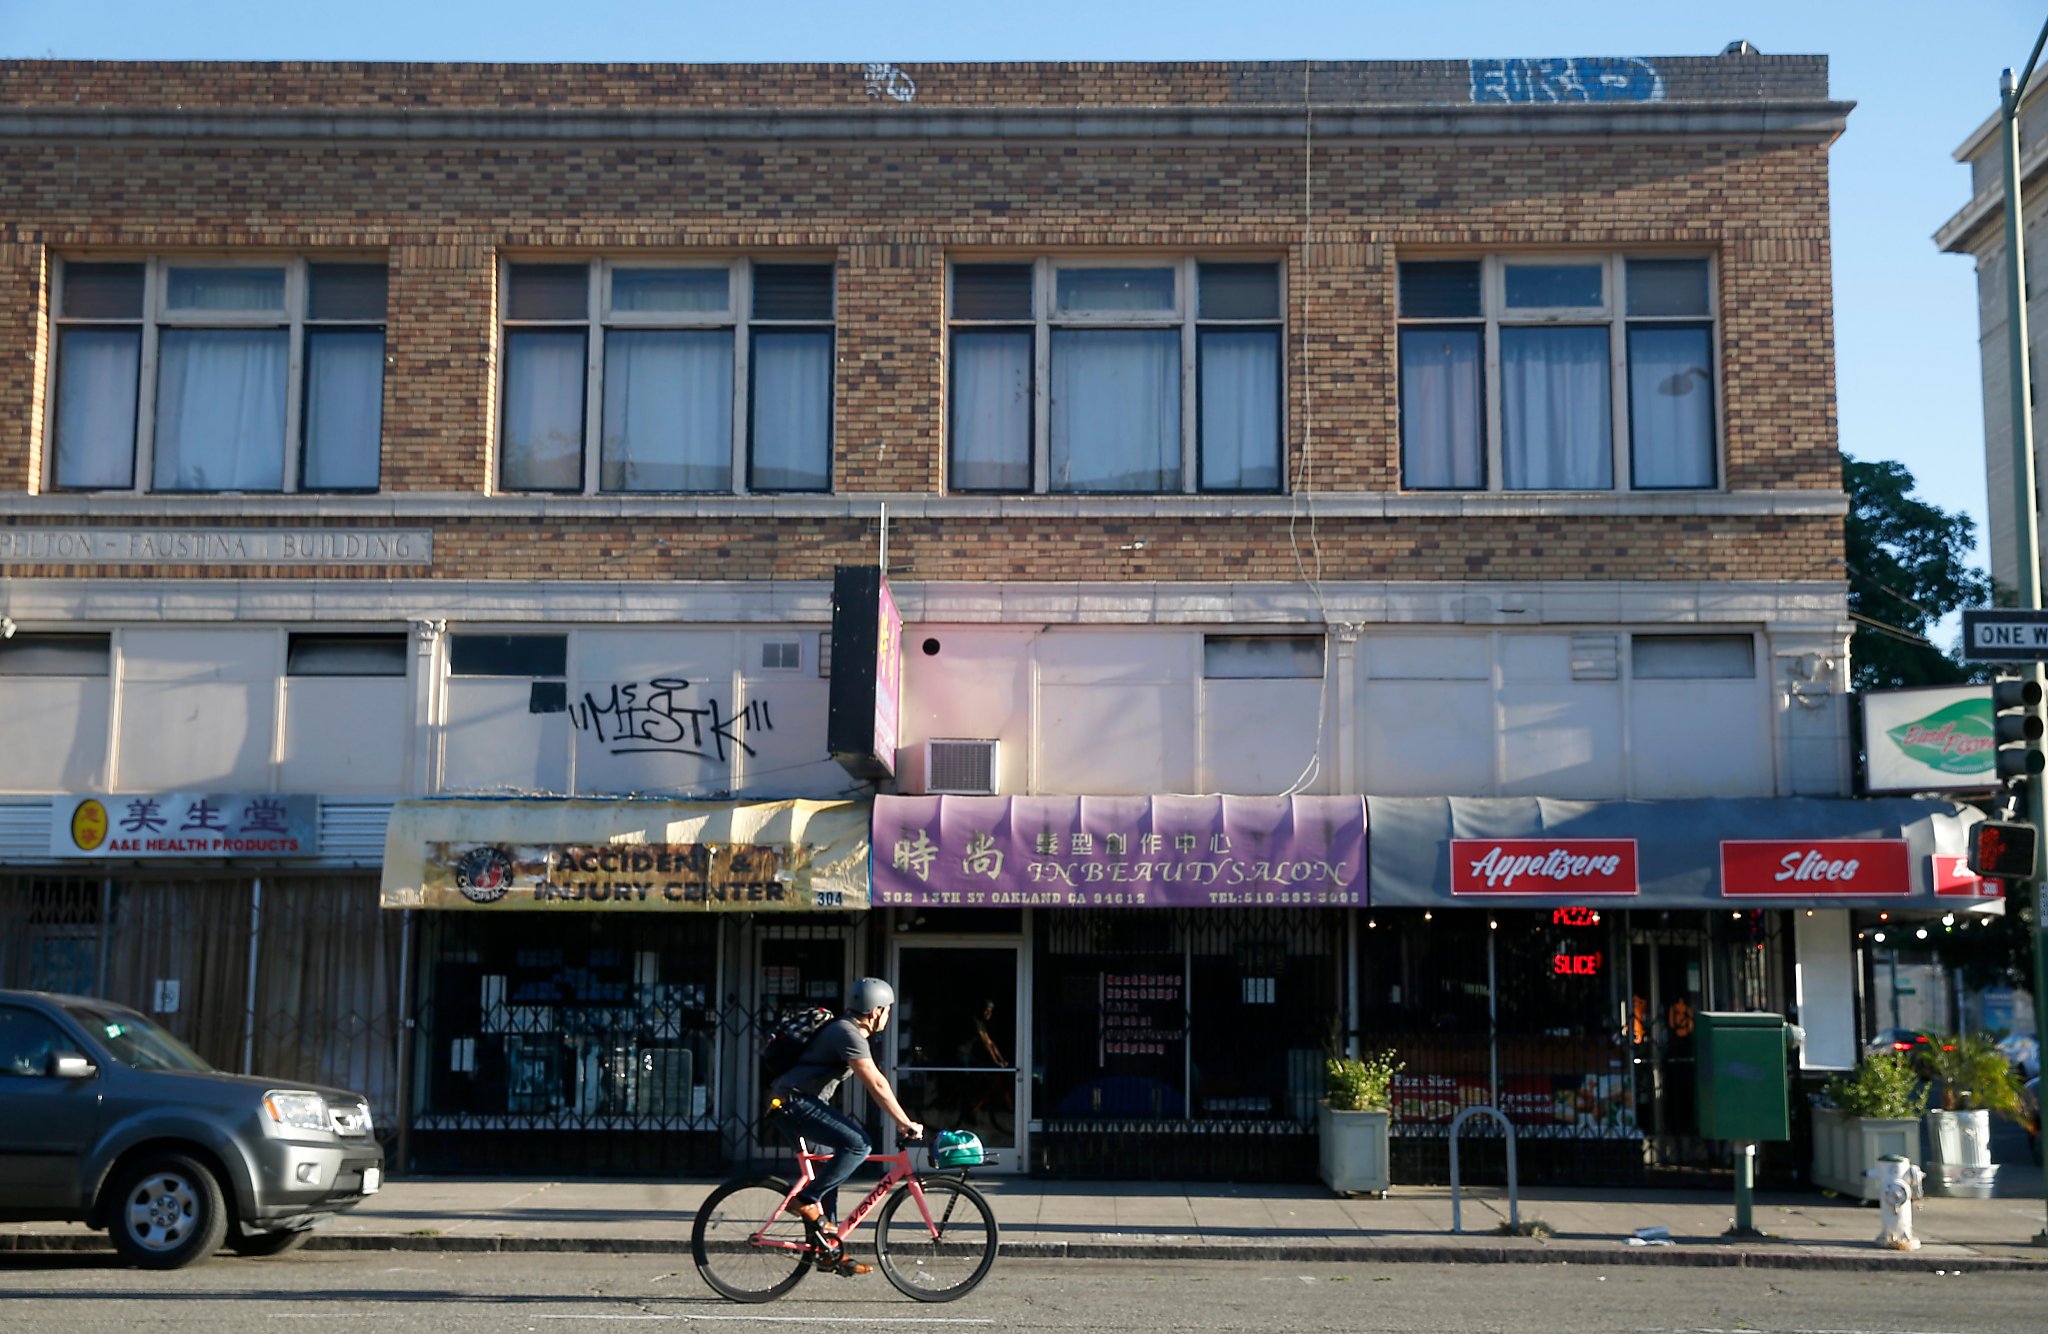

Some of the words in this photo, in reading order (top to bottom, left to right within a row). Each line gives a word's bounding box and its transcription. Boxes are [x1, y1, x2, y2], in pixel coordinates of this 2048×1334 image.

[128, 533, 246, 558] FAUSTINA
[283, 534, 409, 558] BUILDING
[1981, 626, 2025, 644] ONE
[119, 798, 289, 834] 美生堂
[148, 839, 207, 851] HEALTH
[213, 839, 298, 851] PRODUCTS
[892, 829, 1004, 882] 時尚
[557, 851, 703, 873] ACCIDEN
[730, 854, 752, 873] &
[1470, 847, 1621, 887] Appetizers
[1774, 849, 1861, 881] Slices
[534, 882, 654, 901] INJURY
[664, 882, 784, 901] CENTER
[817, 891, 843, 905] 304
[883, 891, 913, 904] 302
[922, 891, 961, 904] 13TH
[967, 891, 985, 904] ST
[991, 891, 1062, 904] OAKLAND
[1068, 891, 1087, 905] CA
[847, 1175, 893, 1230] AVENTON
